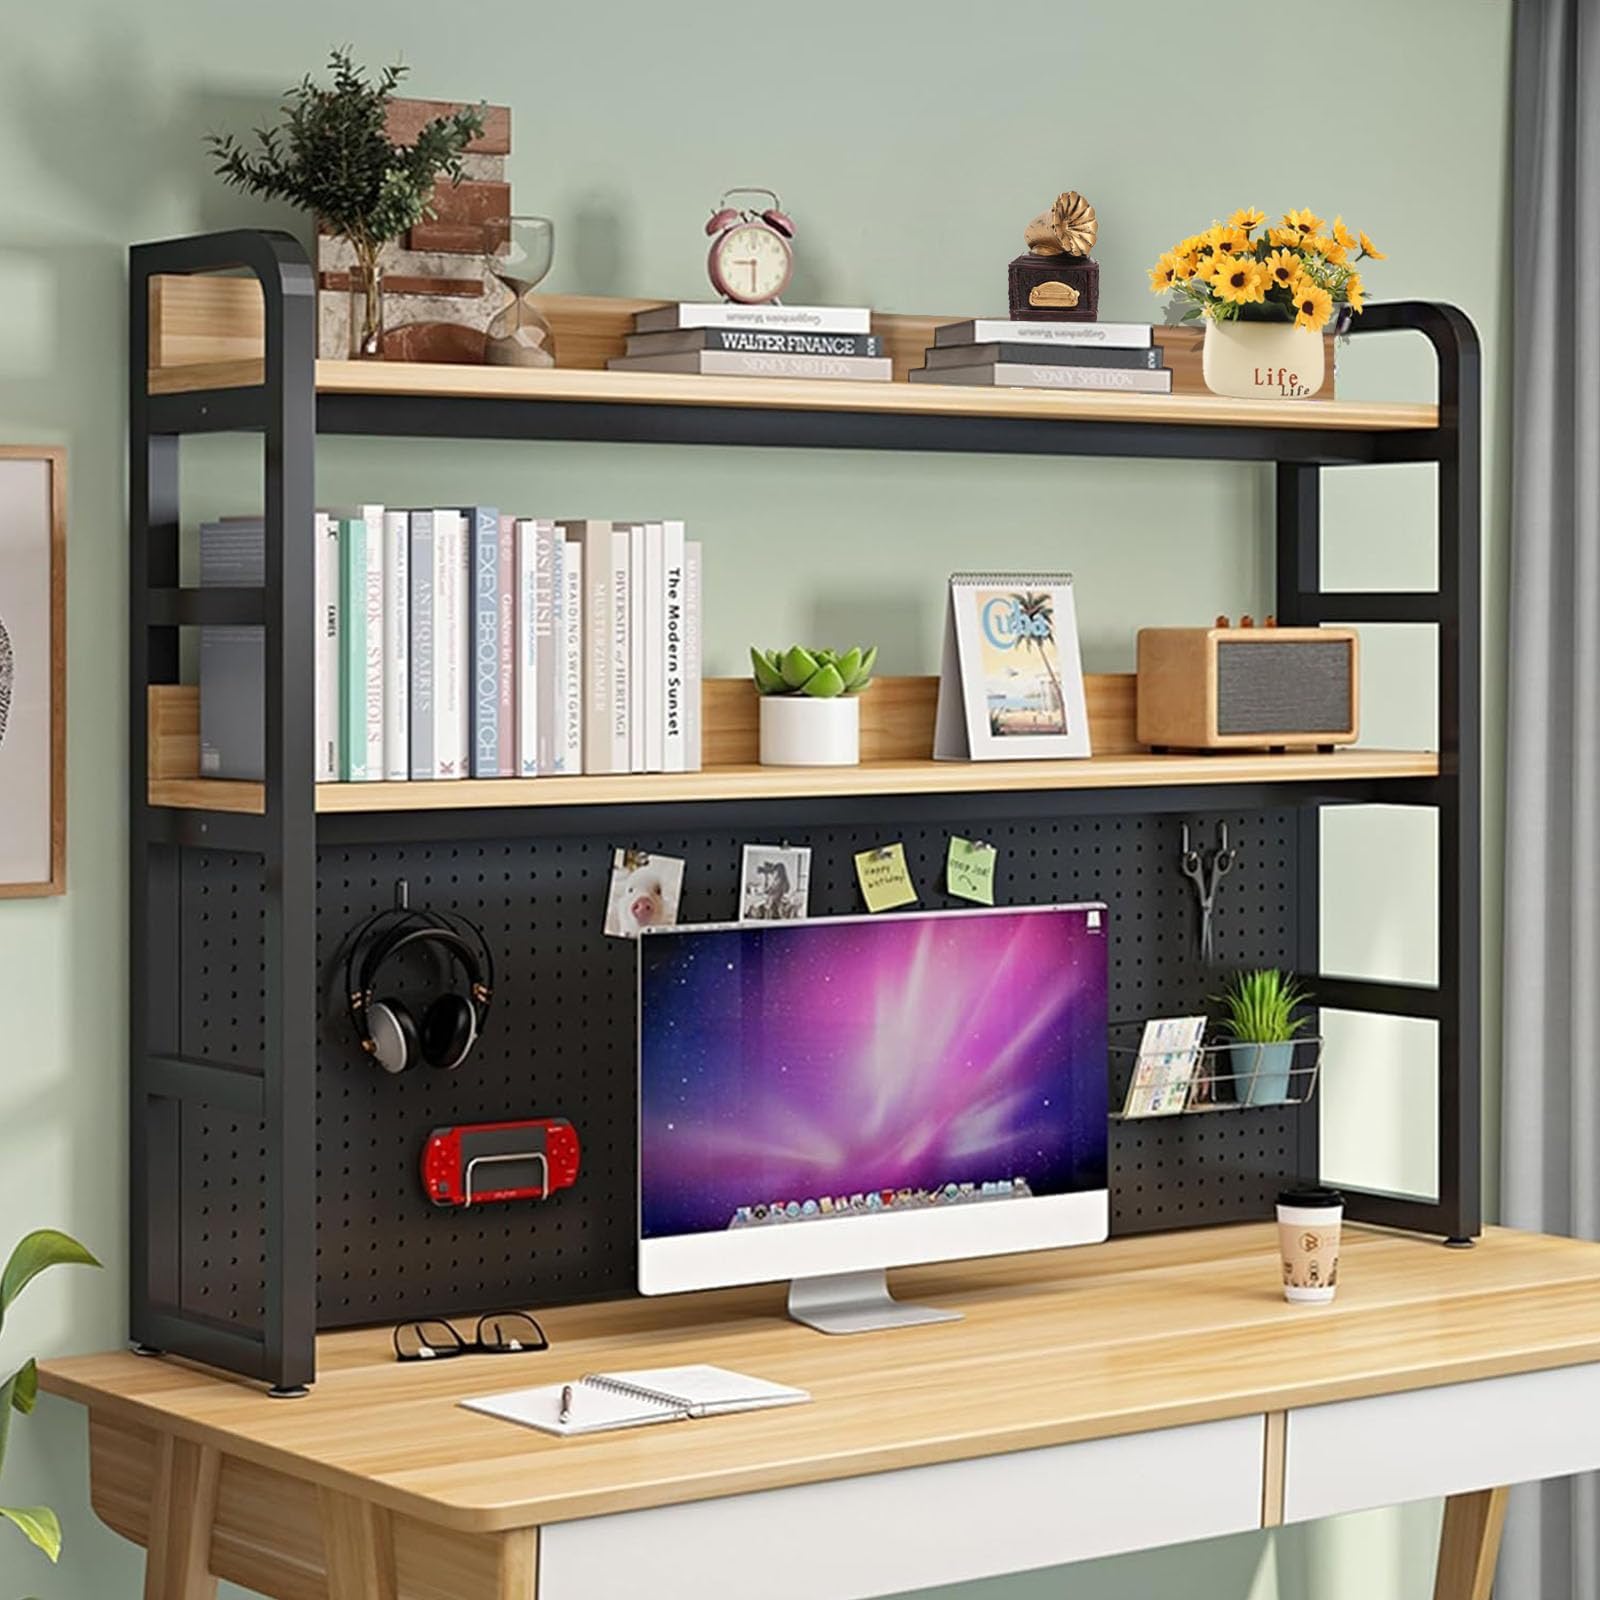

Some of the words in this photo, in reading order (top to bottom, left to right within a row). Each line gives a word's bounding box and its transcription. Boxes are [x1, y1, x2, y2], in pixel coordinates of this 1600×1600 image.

[721, 332, 785, 351] WALTER
[787, 335, 855, 355] FINANCE
[1254, 367, 1298, 386] Life
[1281, 385, 1310, 397] Life
[479, 513, 497, 604] ALEXEY
[668, 567, 681, 599] The
[327, 605, 336, 638] EAMES
[367, 570, 381, 625] BOOK
[501, 593, 512, 645] Gardens
[567, 572, 578, 645] BRAIDING
[615, 570, 626, 646] DIVERSITY
[982, 597, 1050, 650] Cuba
[502, 647, 512, 661] in
[668, 605, 681, 672] Modern
[367, 646, 381, 743] SYMBOLS
[479, 611, 497, 761] BRODOVITCH
[501, 664, 512, 706] France
[567, 651, 578, 749] SWEETGRASS
[615, 668, 626, 738] HERITAGE
[668, 677, 681, 737] Sunset
